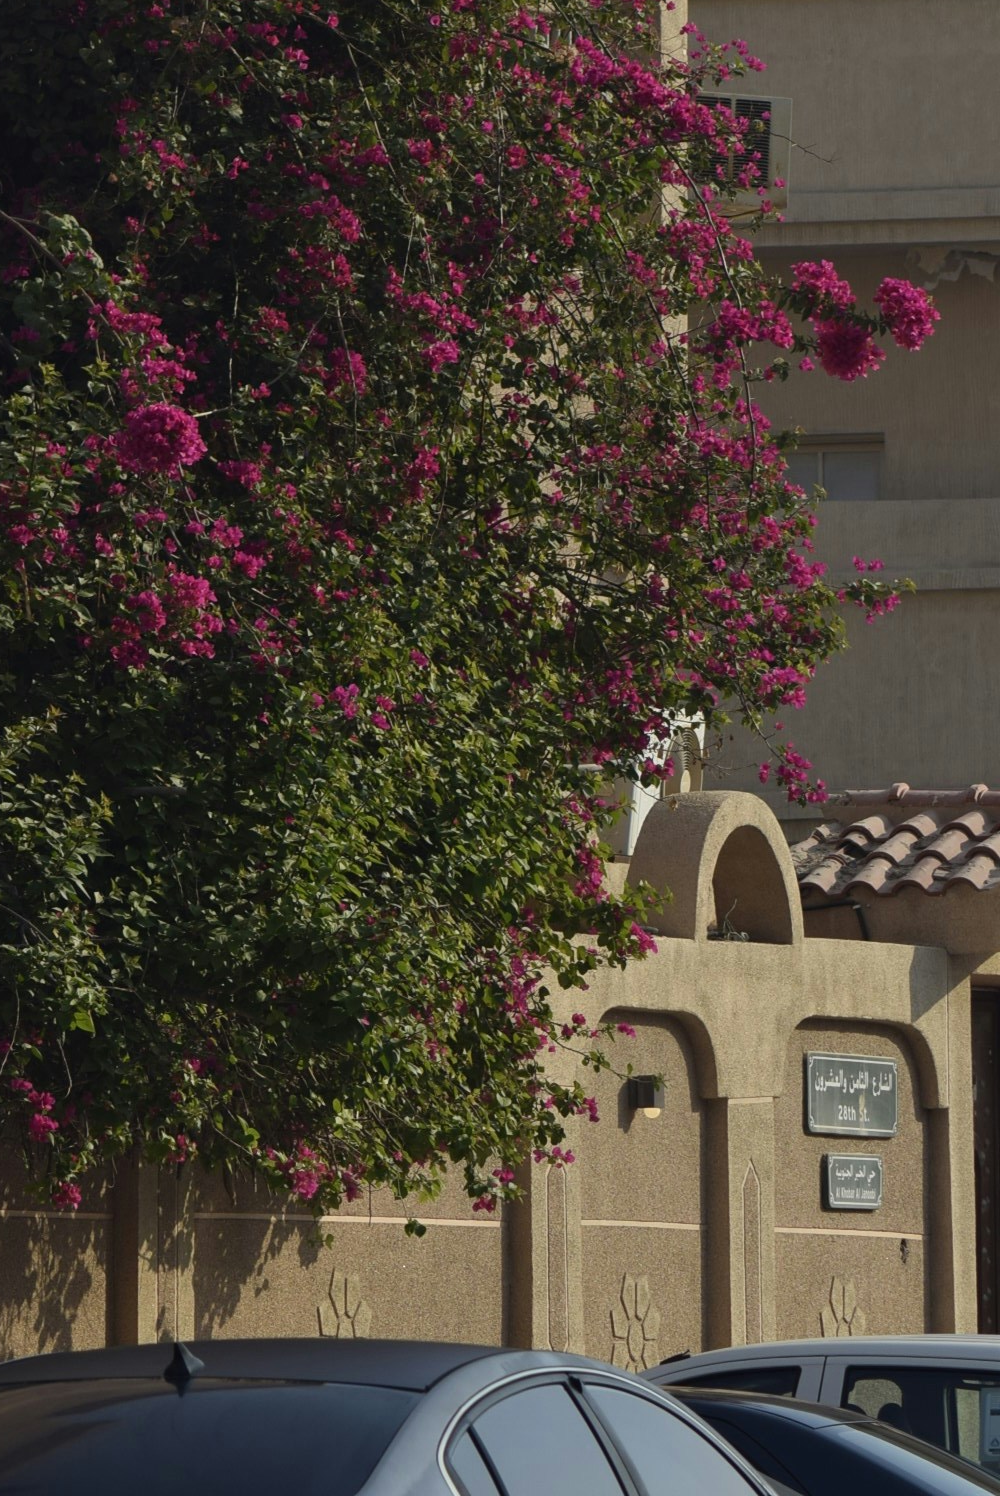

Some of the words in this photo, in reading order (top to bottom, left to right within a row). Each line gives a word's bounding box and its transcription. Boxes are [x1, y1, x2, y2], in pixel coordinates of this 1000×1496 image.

[815, 1068, 847, 1094] والعشرون
[849, 1070, 869, 1094] الثامن
[872, 1071, 892, 1096] الشارع
[838, 1104, 857, 1121] 28th
[859, 1108, 870, 1122] St.
